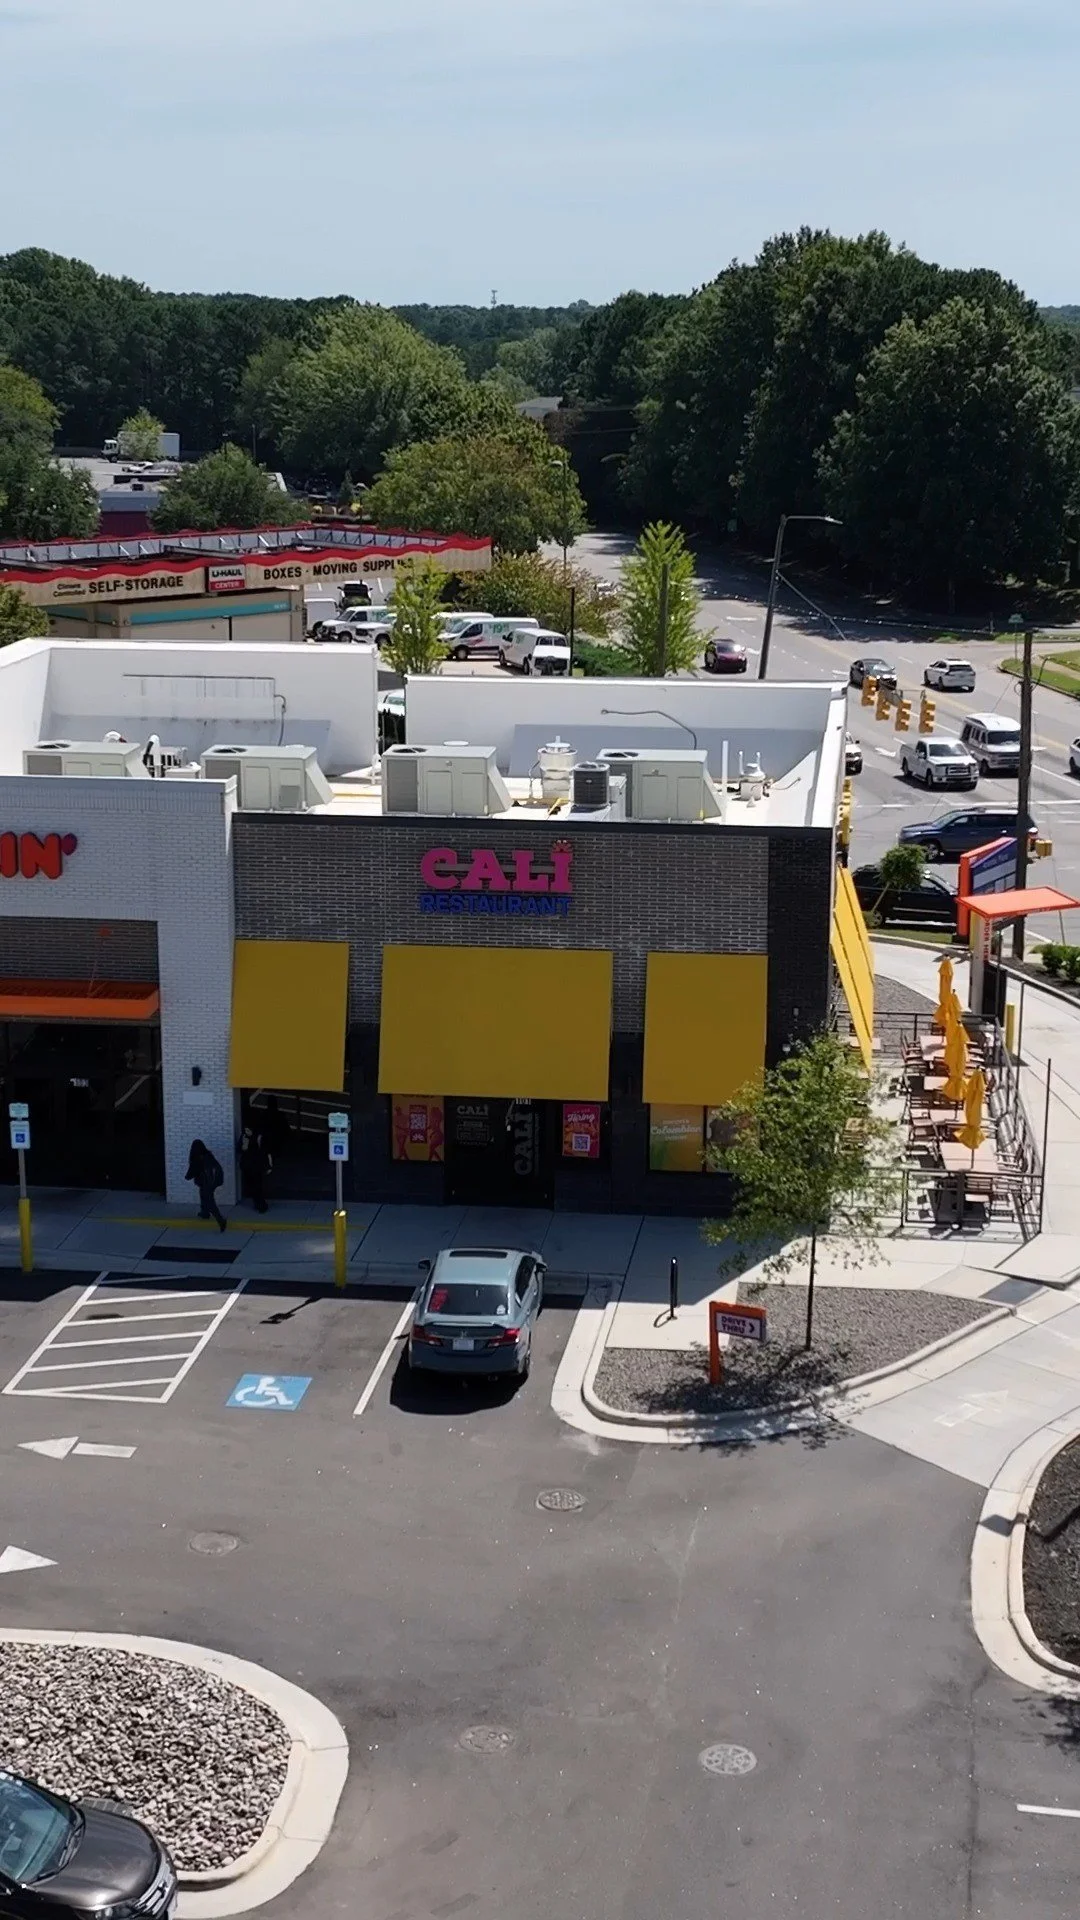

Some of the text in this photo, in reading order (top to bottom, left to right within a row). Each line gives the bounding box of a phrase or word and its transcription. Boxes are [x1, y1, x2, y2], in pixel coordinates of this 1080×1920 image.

[211, 568, 243, 578] U-HAUL
[263, 566, 302, 580] BOXES
[313, 561, 358, 576] MOVING
[88, 575, 184, 594] SELF-STORAGE
[214, 581, 241, 589] CENTER
[420, 840, 573, 893] CALI
[419, 893, 571, 916] RESTAURANT
[457, 1104, 489, 1116] CALI
[513, 1112, 533, 1176] CALI
[721, 1316, 747, 1327] DRIVE
[722, 1323, 746, 1334] THRU
